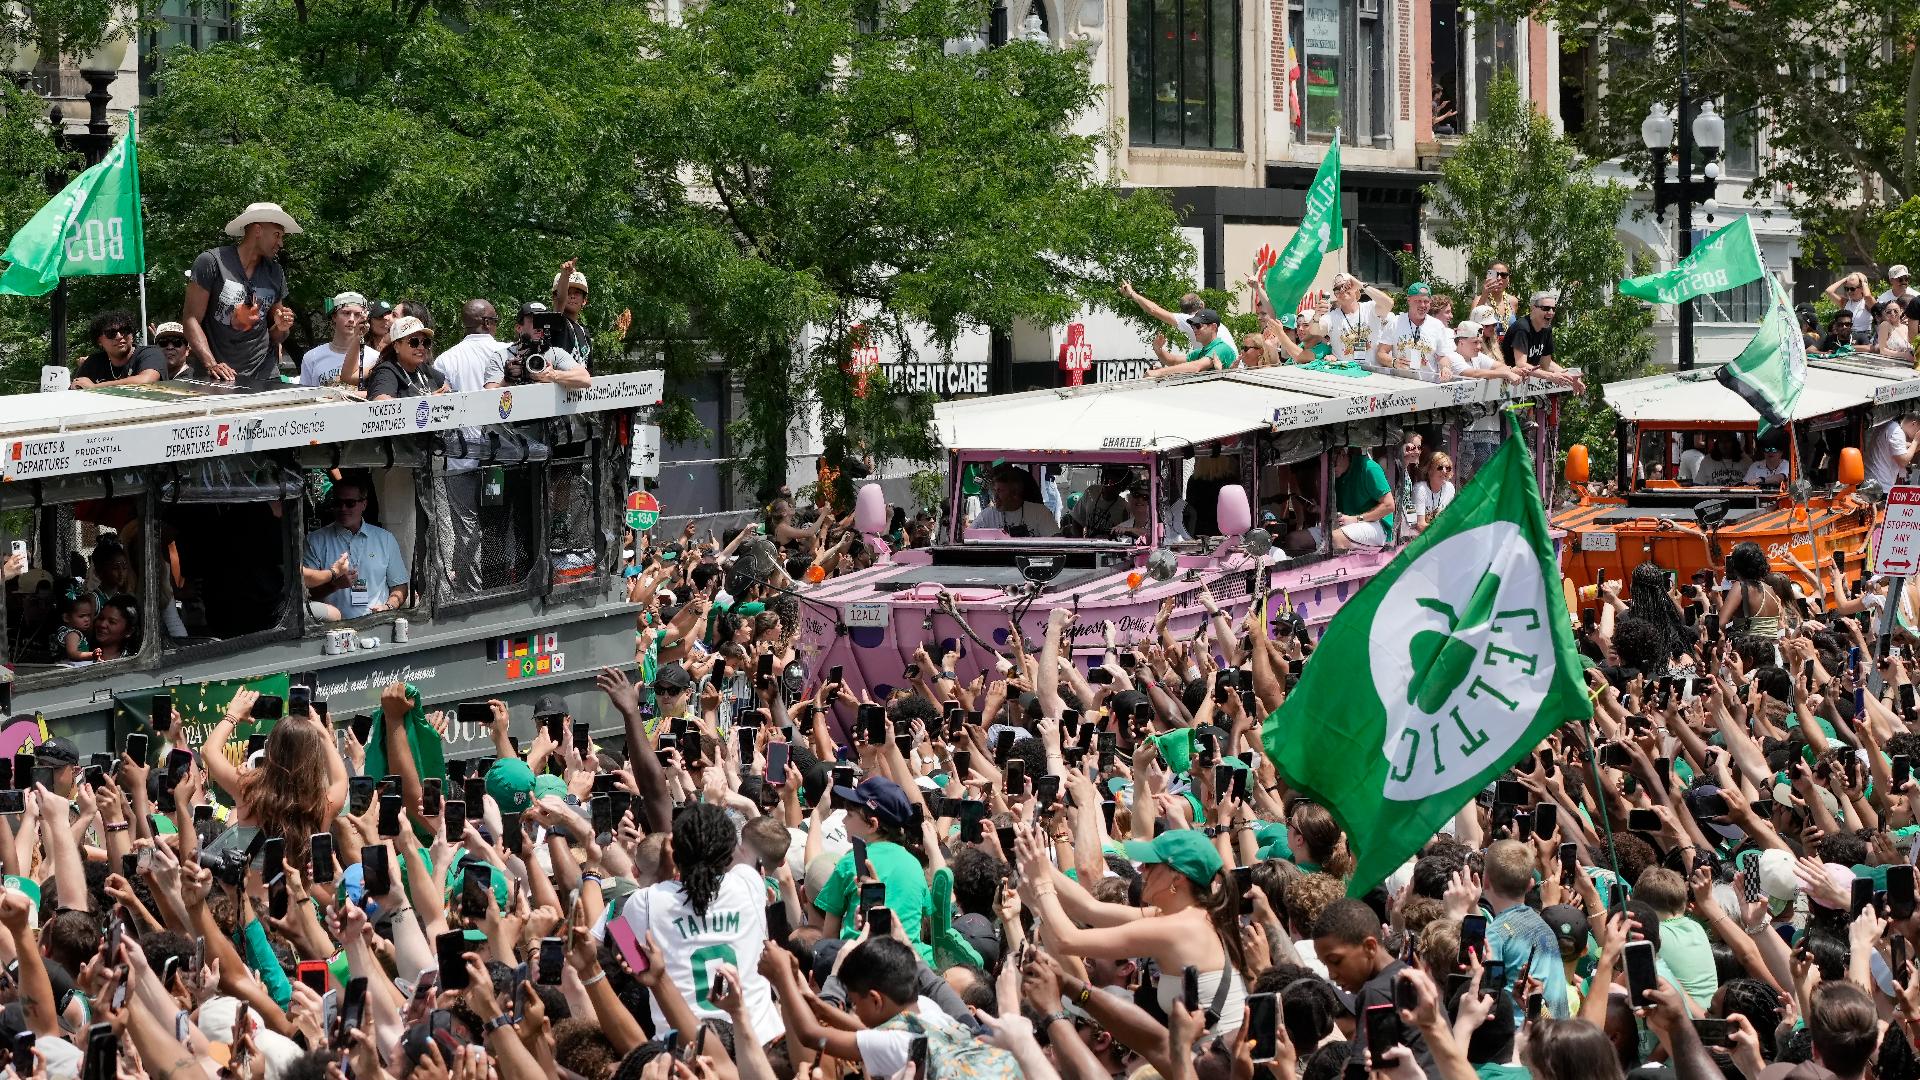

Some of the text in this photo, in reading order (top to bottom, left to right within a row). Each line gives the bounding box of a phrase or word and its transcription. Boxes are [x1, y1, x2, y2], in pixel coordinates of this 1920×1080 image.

[946, 362, 988, 394] CARE
[1096, 361, 1150, 384] URGEN
[368, 402, 396, 418] TICKETS
[172, 425, 204, 441] TICKETS
[232, 420, 325, 442] Museum of Science
[361, 417, 406, 434] DEPARTURES
[24, 441, 58, 457] TICKETS
[165, 440, 215, 458] DEPARTURES
[1102, 437, 1142, 448] CHARTER
[16, 456, 70, 475] DEPARTURES
[82, 456, 113, 468] CENTER
[635, 494, 647, 510] F
[1892, 491, 1920, 502] TOW ZO
[1902, 508, 1914, 518] NO
[1893, 533, 1911, 543] ANY
[1891, 546, 1909, 556] TIME
[315, 664, 437, 702] riginal and World Famous
[182, 723, 203, 745] 024
[825, 826, 846, 843] TA
[672, 911, 740, 940] TATUM
[690, 943, 739, 1011] 0
